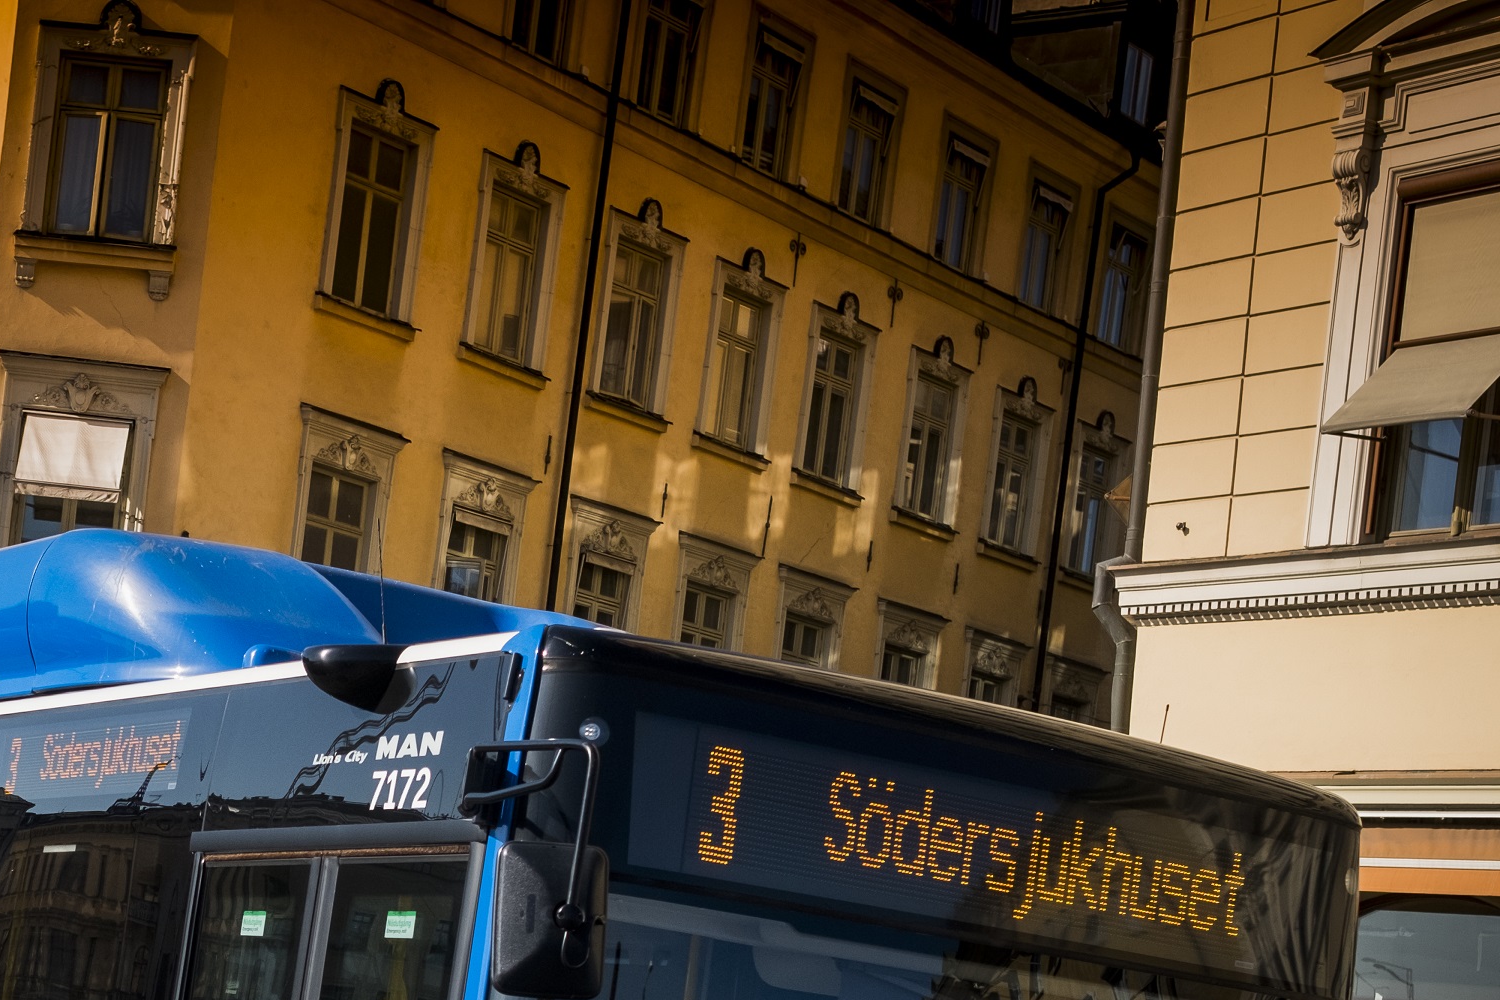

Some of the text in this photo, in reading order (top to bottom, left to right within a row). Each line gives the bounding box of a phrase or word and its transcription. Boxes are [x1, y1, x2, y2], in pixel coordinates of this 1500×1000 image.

[4, 720, 181, 795] 3 Södersjukhuset
[312, 730, 444, 766] Lion's City MAN
[368, 767, 432, 811] 7172
[698, 745, 1245, 937] 3 Södersjukhuset
